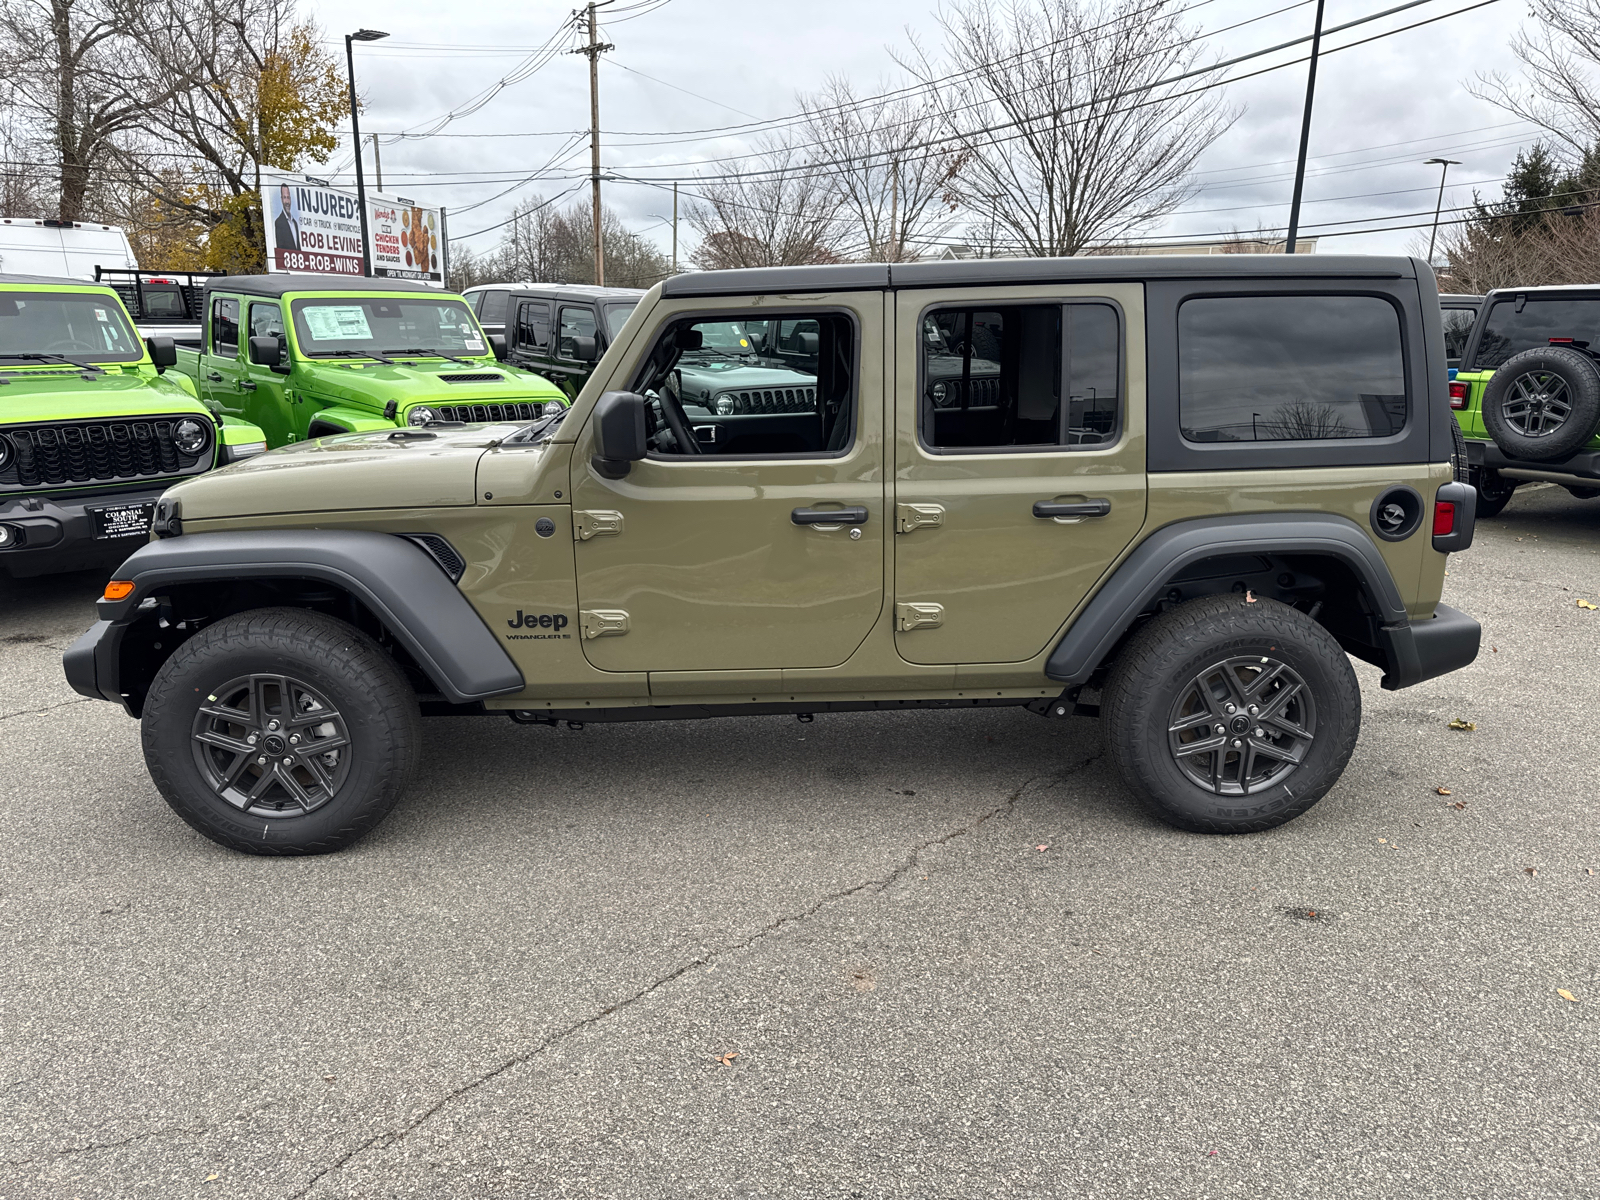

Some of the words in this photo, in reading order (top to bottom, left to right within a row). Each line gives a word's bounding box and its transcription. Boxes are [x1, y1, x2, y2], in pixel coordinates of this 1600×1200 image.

[296, 187, 360, 220] INJURED?
[374, 207, 390, 223] Wendy's
[303, 217, 312, 227] CAR
[318, 219, 332, 230] TRUCK
[338, 222, 361, 234] MOTORCYCLE
[300, 230, 324, 249] ROB
[326, 234, 362, 254] LEVINE
[375, 233, 400, 245] CHICKEN
[376, 244, 400, 255] TENDERS
[386, 255, 401, 263] SAUCES
[386, 269, 396, 277] OPEN
[402, 271, 417, 279] MIDNIGHT
[105, 509, 144, 519] COLONIAL
[113, 514, 138, 522] SOUTH
[507, 609, 568, 632] Jeep
[1173, 637, 1245, 684] ROADIAN
